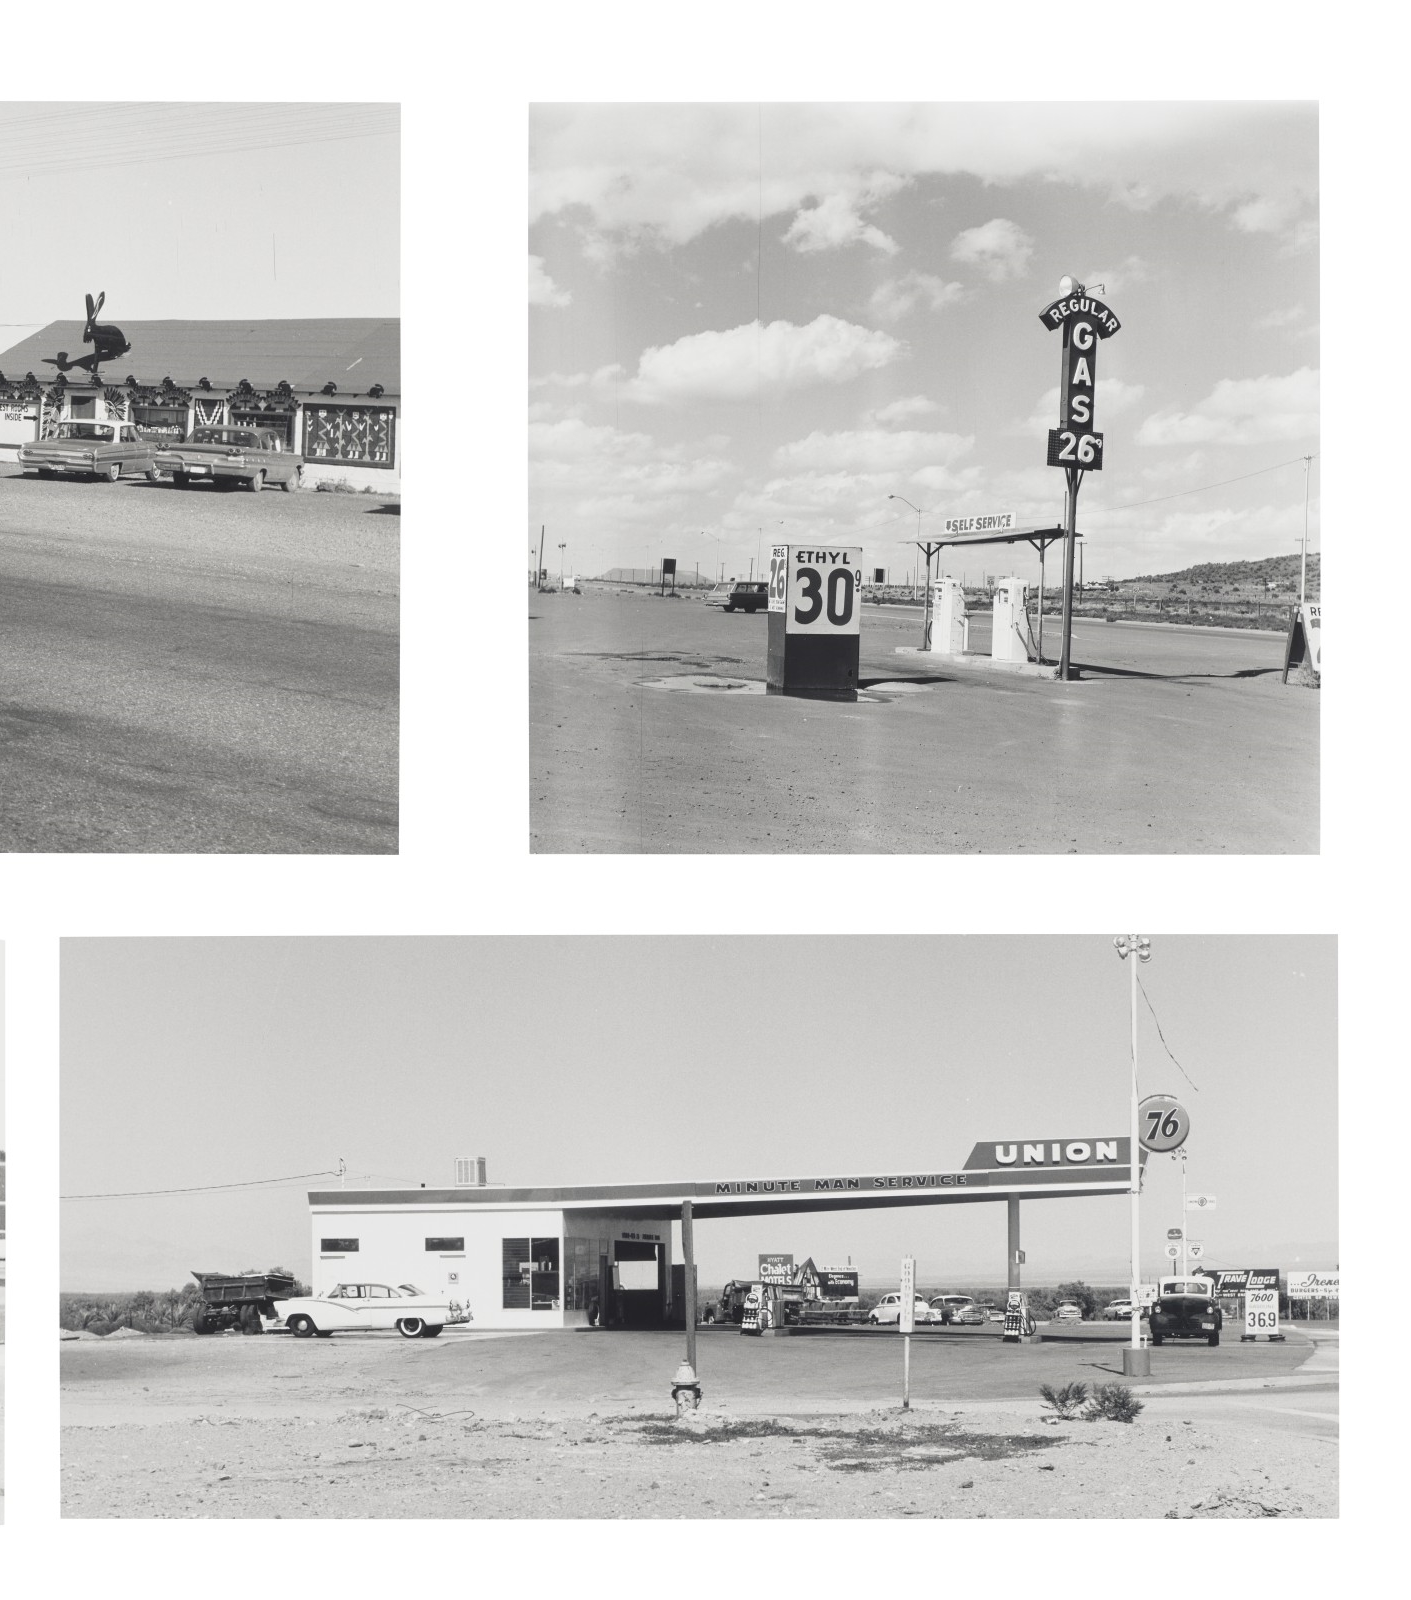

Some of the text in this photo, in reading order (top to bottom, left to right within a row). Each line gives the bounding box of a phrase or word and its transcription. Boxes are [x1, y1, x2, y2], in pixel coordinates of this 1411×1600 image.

[1049, 297, 1118, 333] REGULAR
[1071, 321, 1095, 424] GAS
[11, 403, 29, 413] ROOMS
[4, 413, 22, 422] INSIDE
[951, 514, 1012, 533] SELF SERVICE
[772, 548, 786, 558] REG.
[796, 550, 851, 565] ETHYL
[768, 558, 786, 600] 26
[1145, 1107, 1179, 1141] 76
[995, 1140, 1118, 1164] UNION
[715, 1174, 967, 1193] MINUTE MAN SERVICE
[760, 1263, 792, 1276] Chalet
[760, 1275, 792, 1285] MOTELS
[1249, 1292, 1274, 1303] 7600
[1247, 1311, 1276, 1328] 36.9
